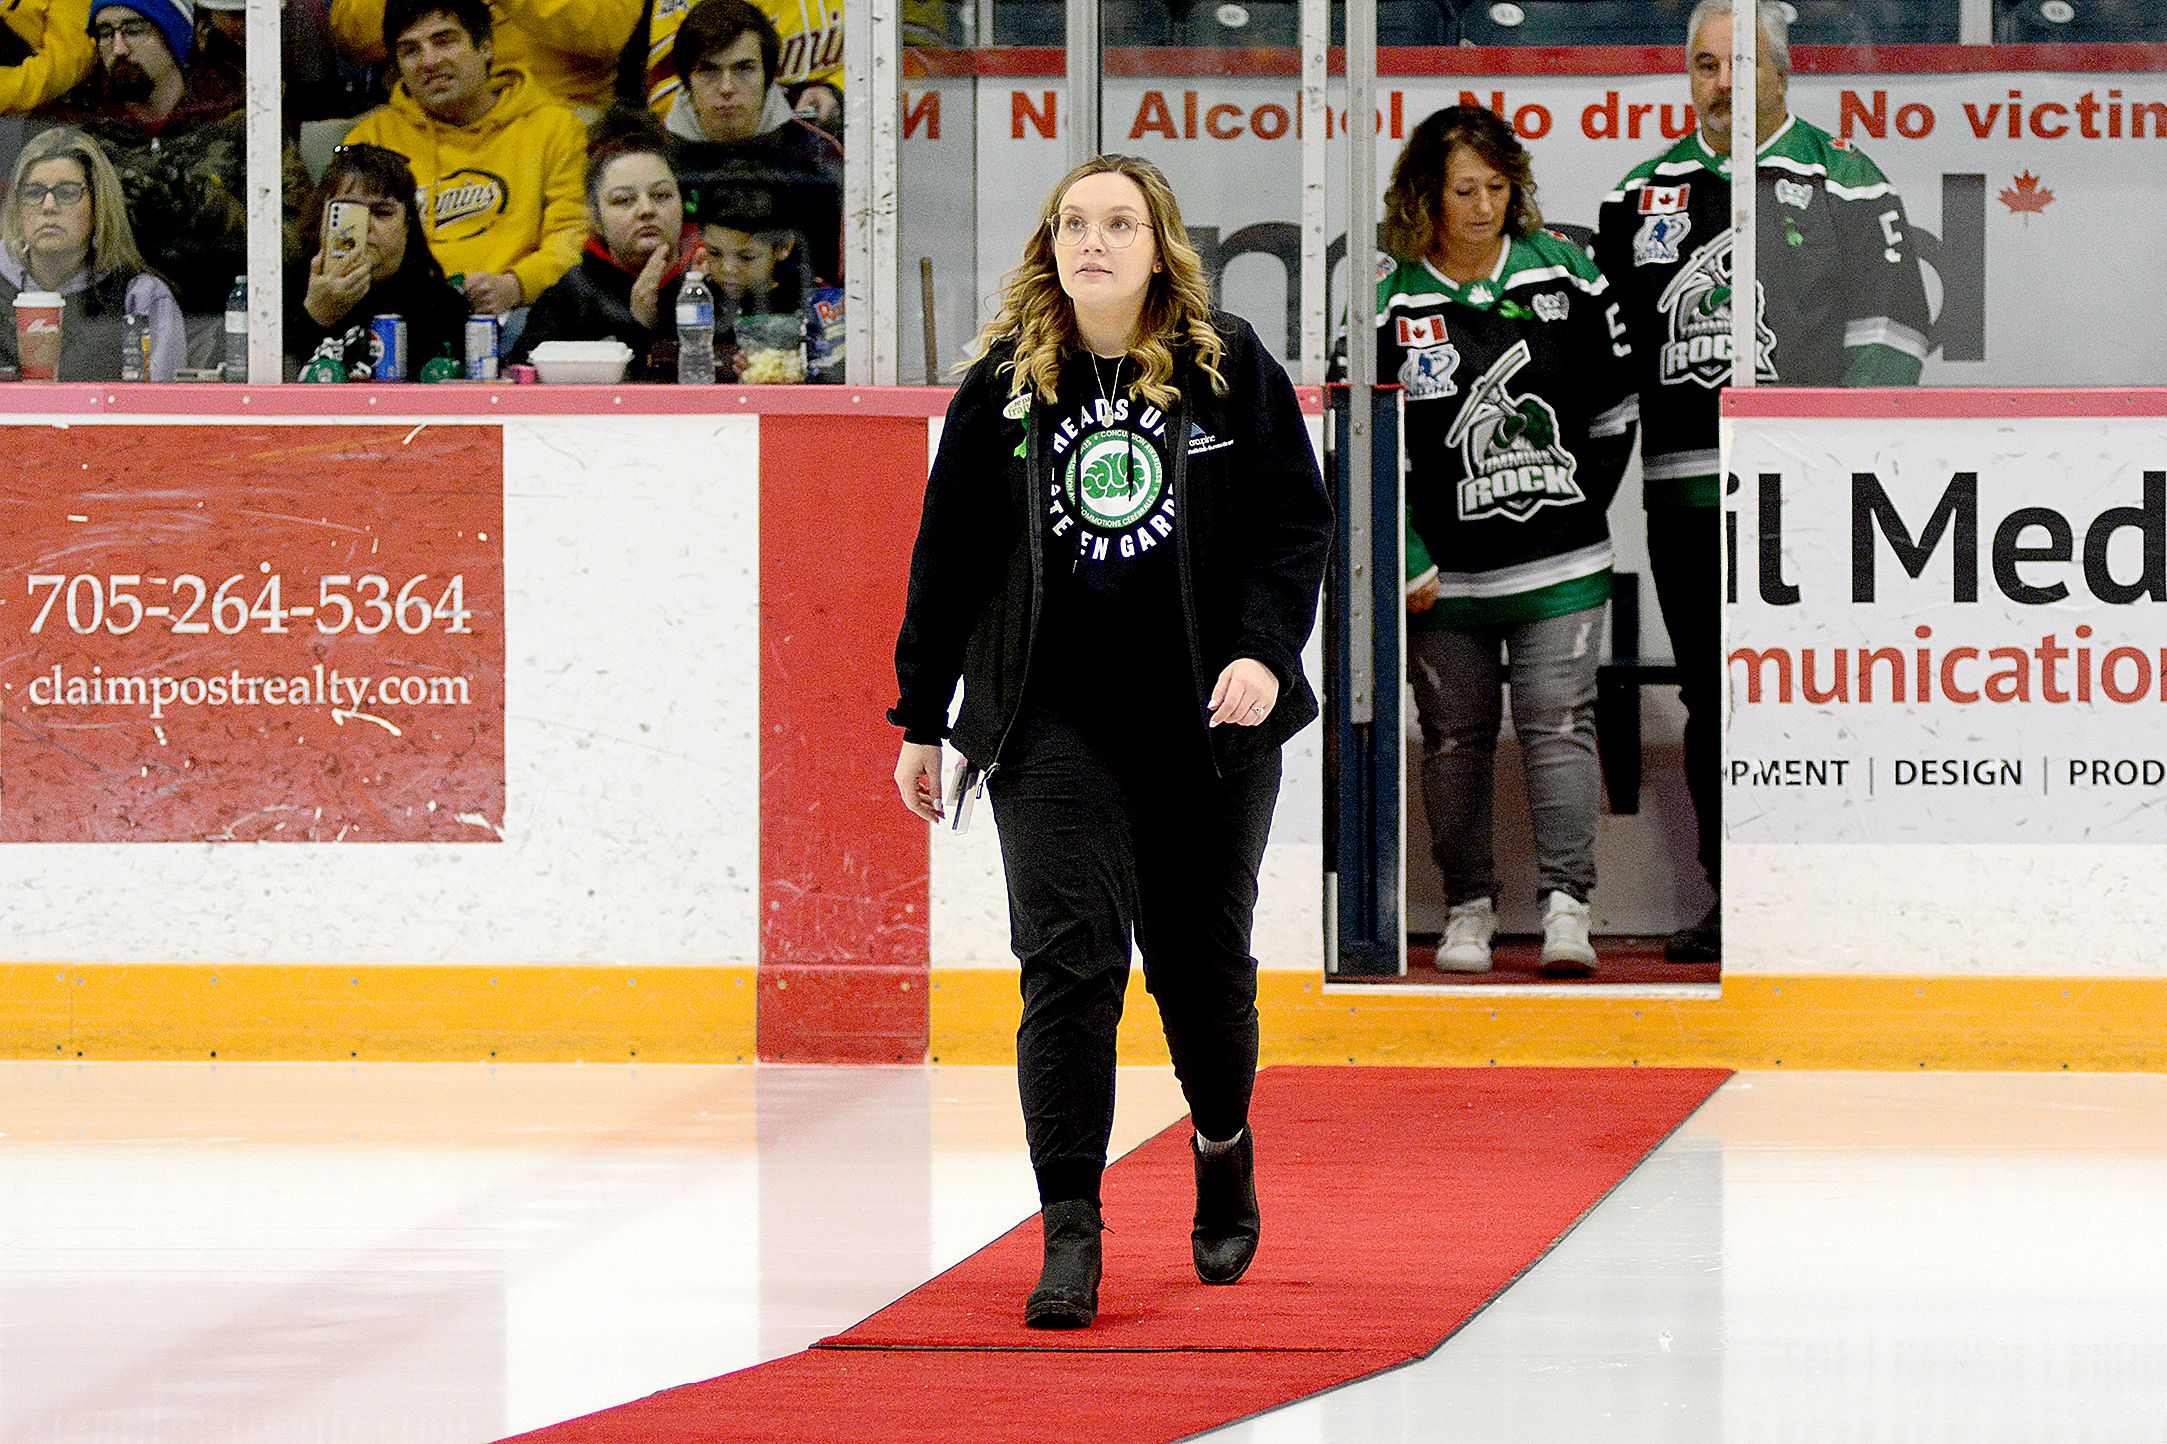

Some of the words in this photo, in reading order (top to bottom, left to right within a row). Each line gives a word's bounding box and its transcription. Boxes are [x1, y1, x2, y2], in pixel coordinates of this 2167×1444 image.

[1012, 91, 1068, 139] N
[1839, 90, 1935, 140] No
[1665, 333, 1769, 380] ROC
[1053, 398, 1129, 454] HEADS
[1463, 464, 1576, 513] ROCK
[1119, 483, 1175, 559] GARD
[1851, 470, 2167, 606] Med
[26, 572, 472, 636] 705-264-5364
[28, 663, 472, 717] claimpostrealty.com
[1727, 624, 2167, 704] municatio
[1724, 759, 1850, 787] PMENT
[1894, 758, 2023, 787] DESIGN
[2069, 758, 2166, 787] PROD
